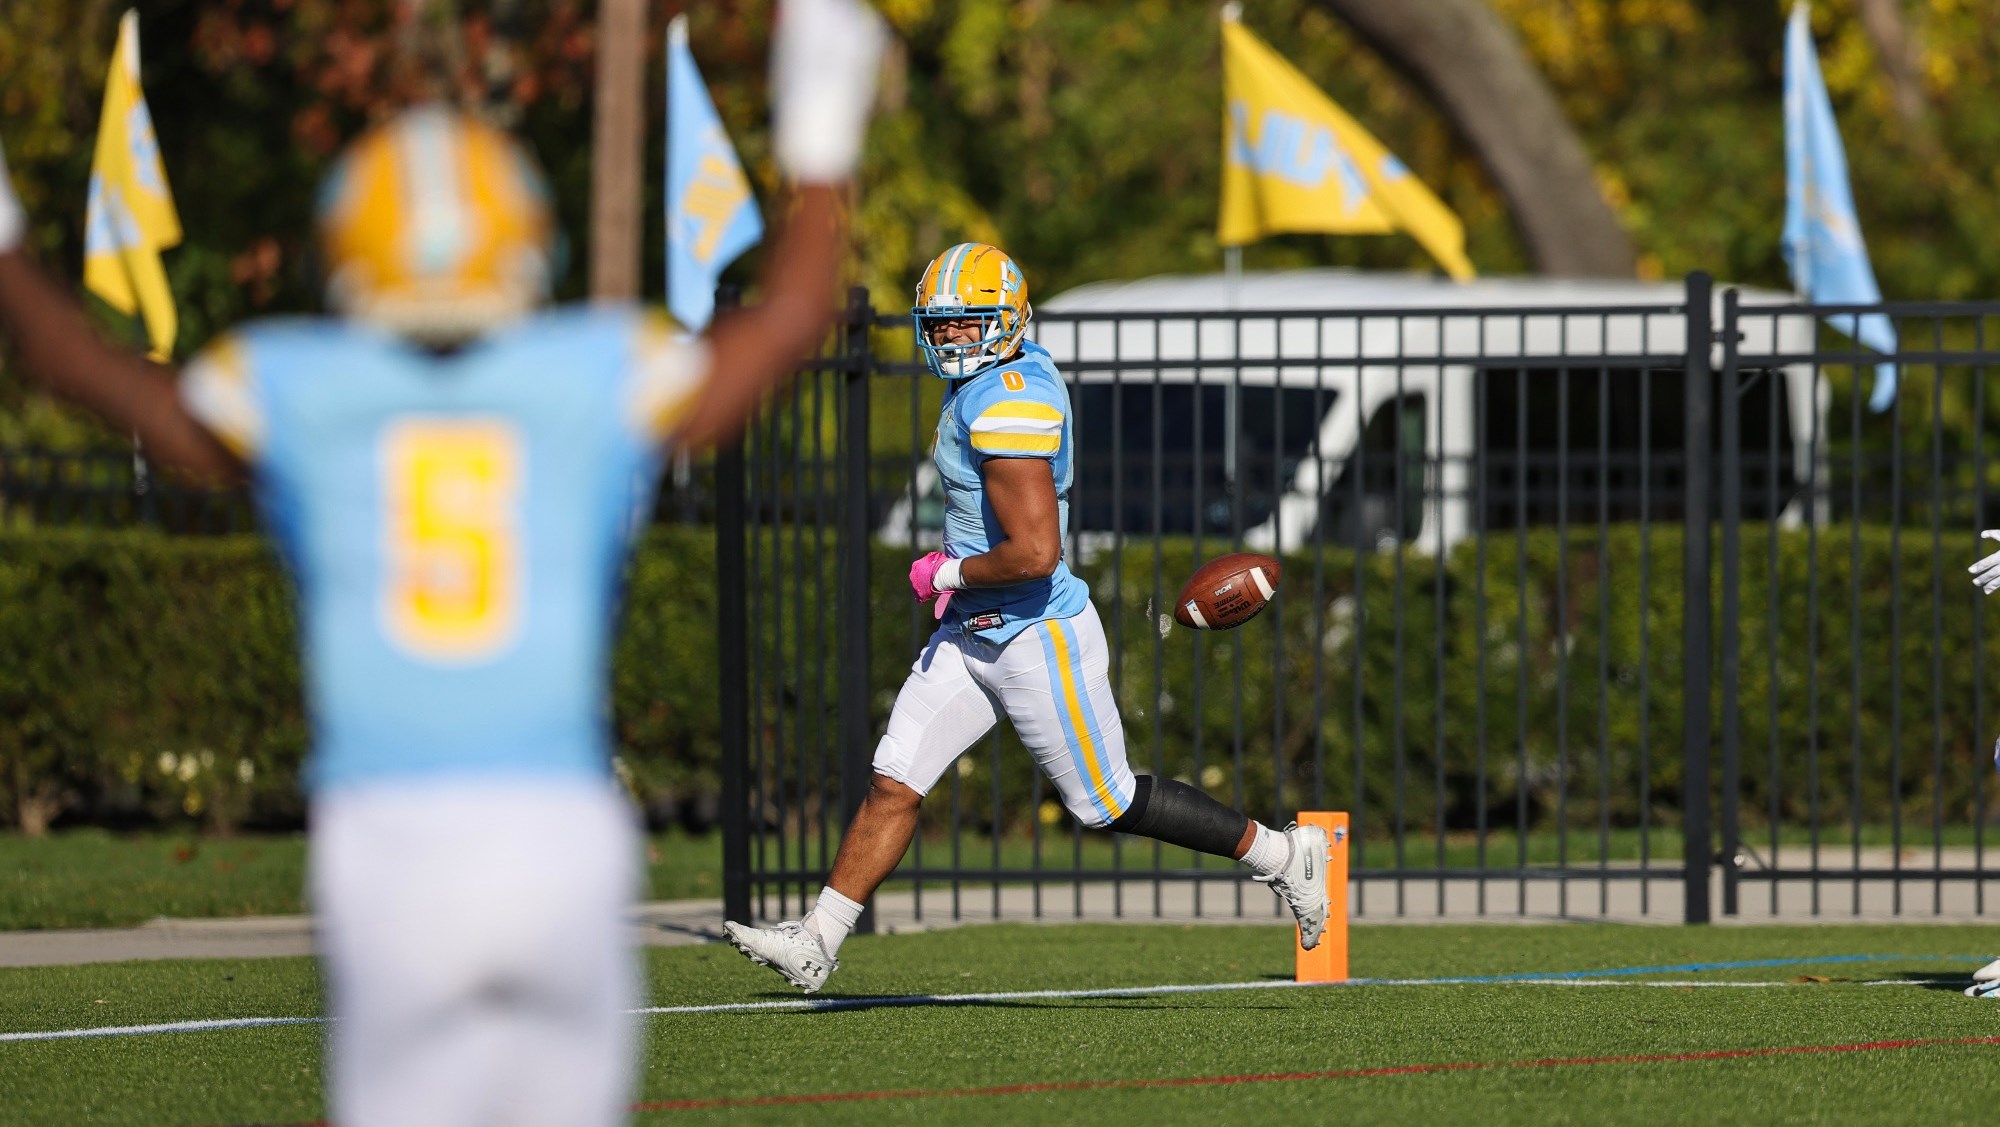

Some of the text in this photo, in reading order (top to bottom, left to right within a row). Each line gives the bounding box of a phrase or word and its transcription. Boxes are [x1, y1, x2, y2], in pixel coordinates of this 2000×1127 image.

[1000, 371, 1026, 392] 0
[378, 416, 525, 661] 5
[1217, 601, 1251, 618] Wilson
